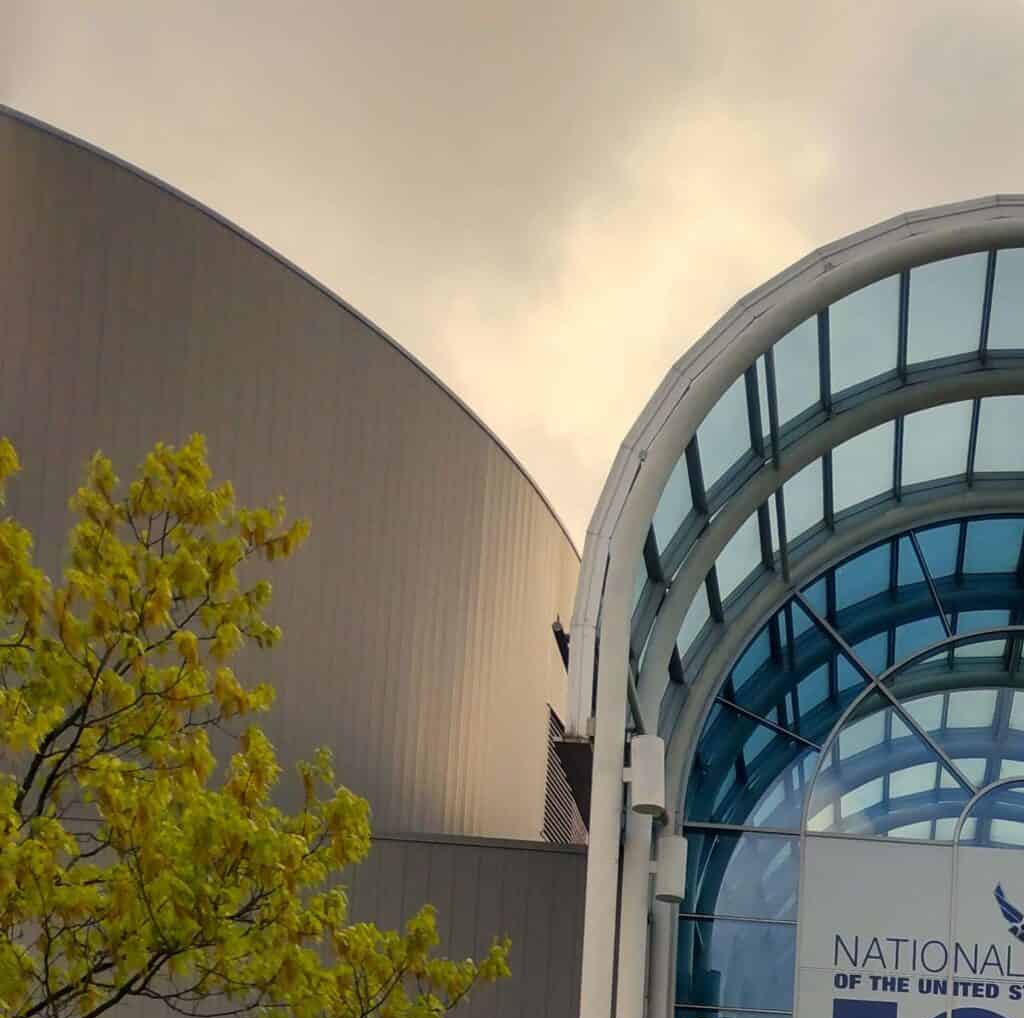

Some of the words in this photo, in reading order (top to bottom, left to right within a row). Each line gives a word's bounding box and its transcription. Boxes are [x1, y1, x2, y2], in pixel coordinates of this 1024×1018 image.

[833, 973, 862, 990] OF
[869, 975, 910, 993] THE
[918, 978, 1000, 999] UNITED
